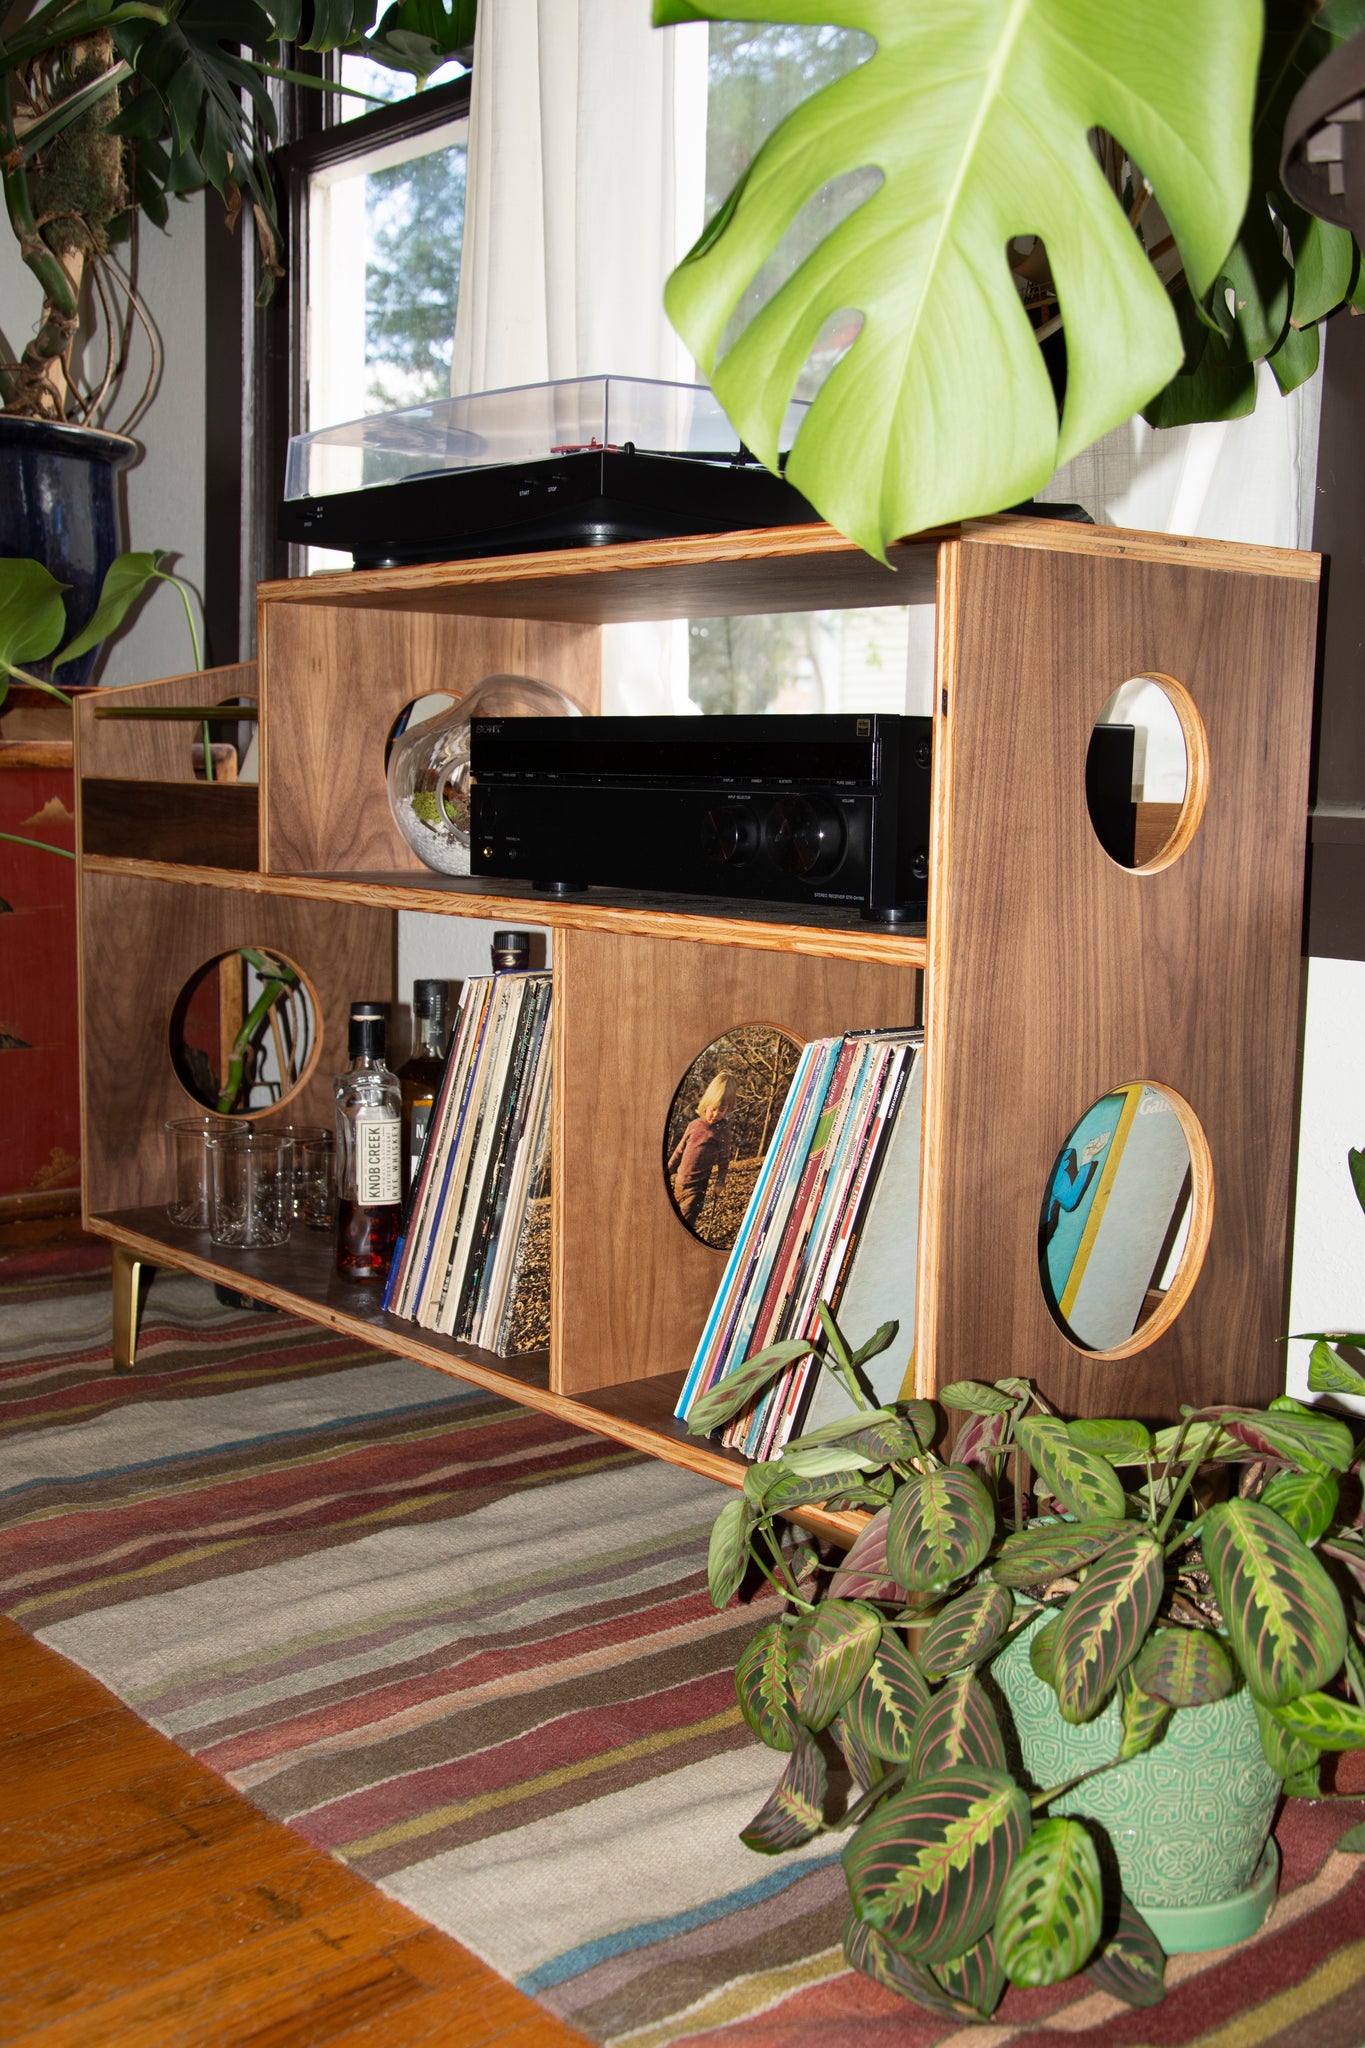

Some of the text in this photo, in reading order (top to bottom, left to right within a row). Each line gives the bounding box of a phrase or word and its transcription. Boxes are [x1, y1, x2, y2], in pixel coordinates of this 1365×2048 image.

[369, 1128, 380, 1197] KNOB CREEK
[856, 1147, 871, 1186] CAROLINE
[849, 1189, 858, 1209] ROSE
